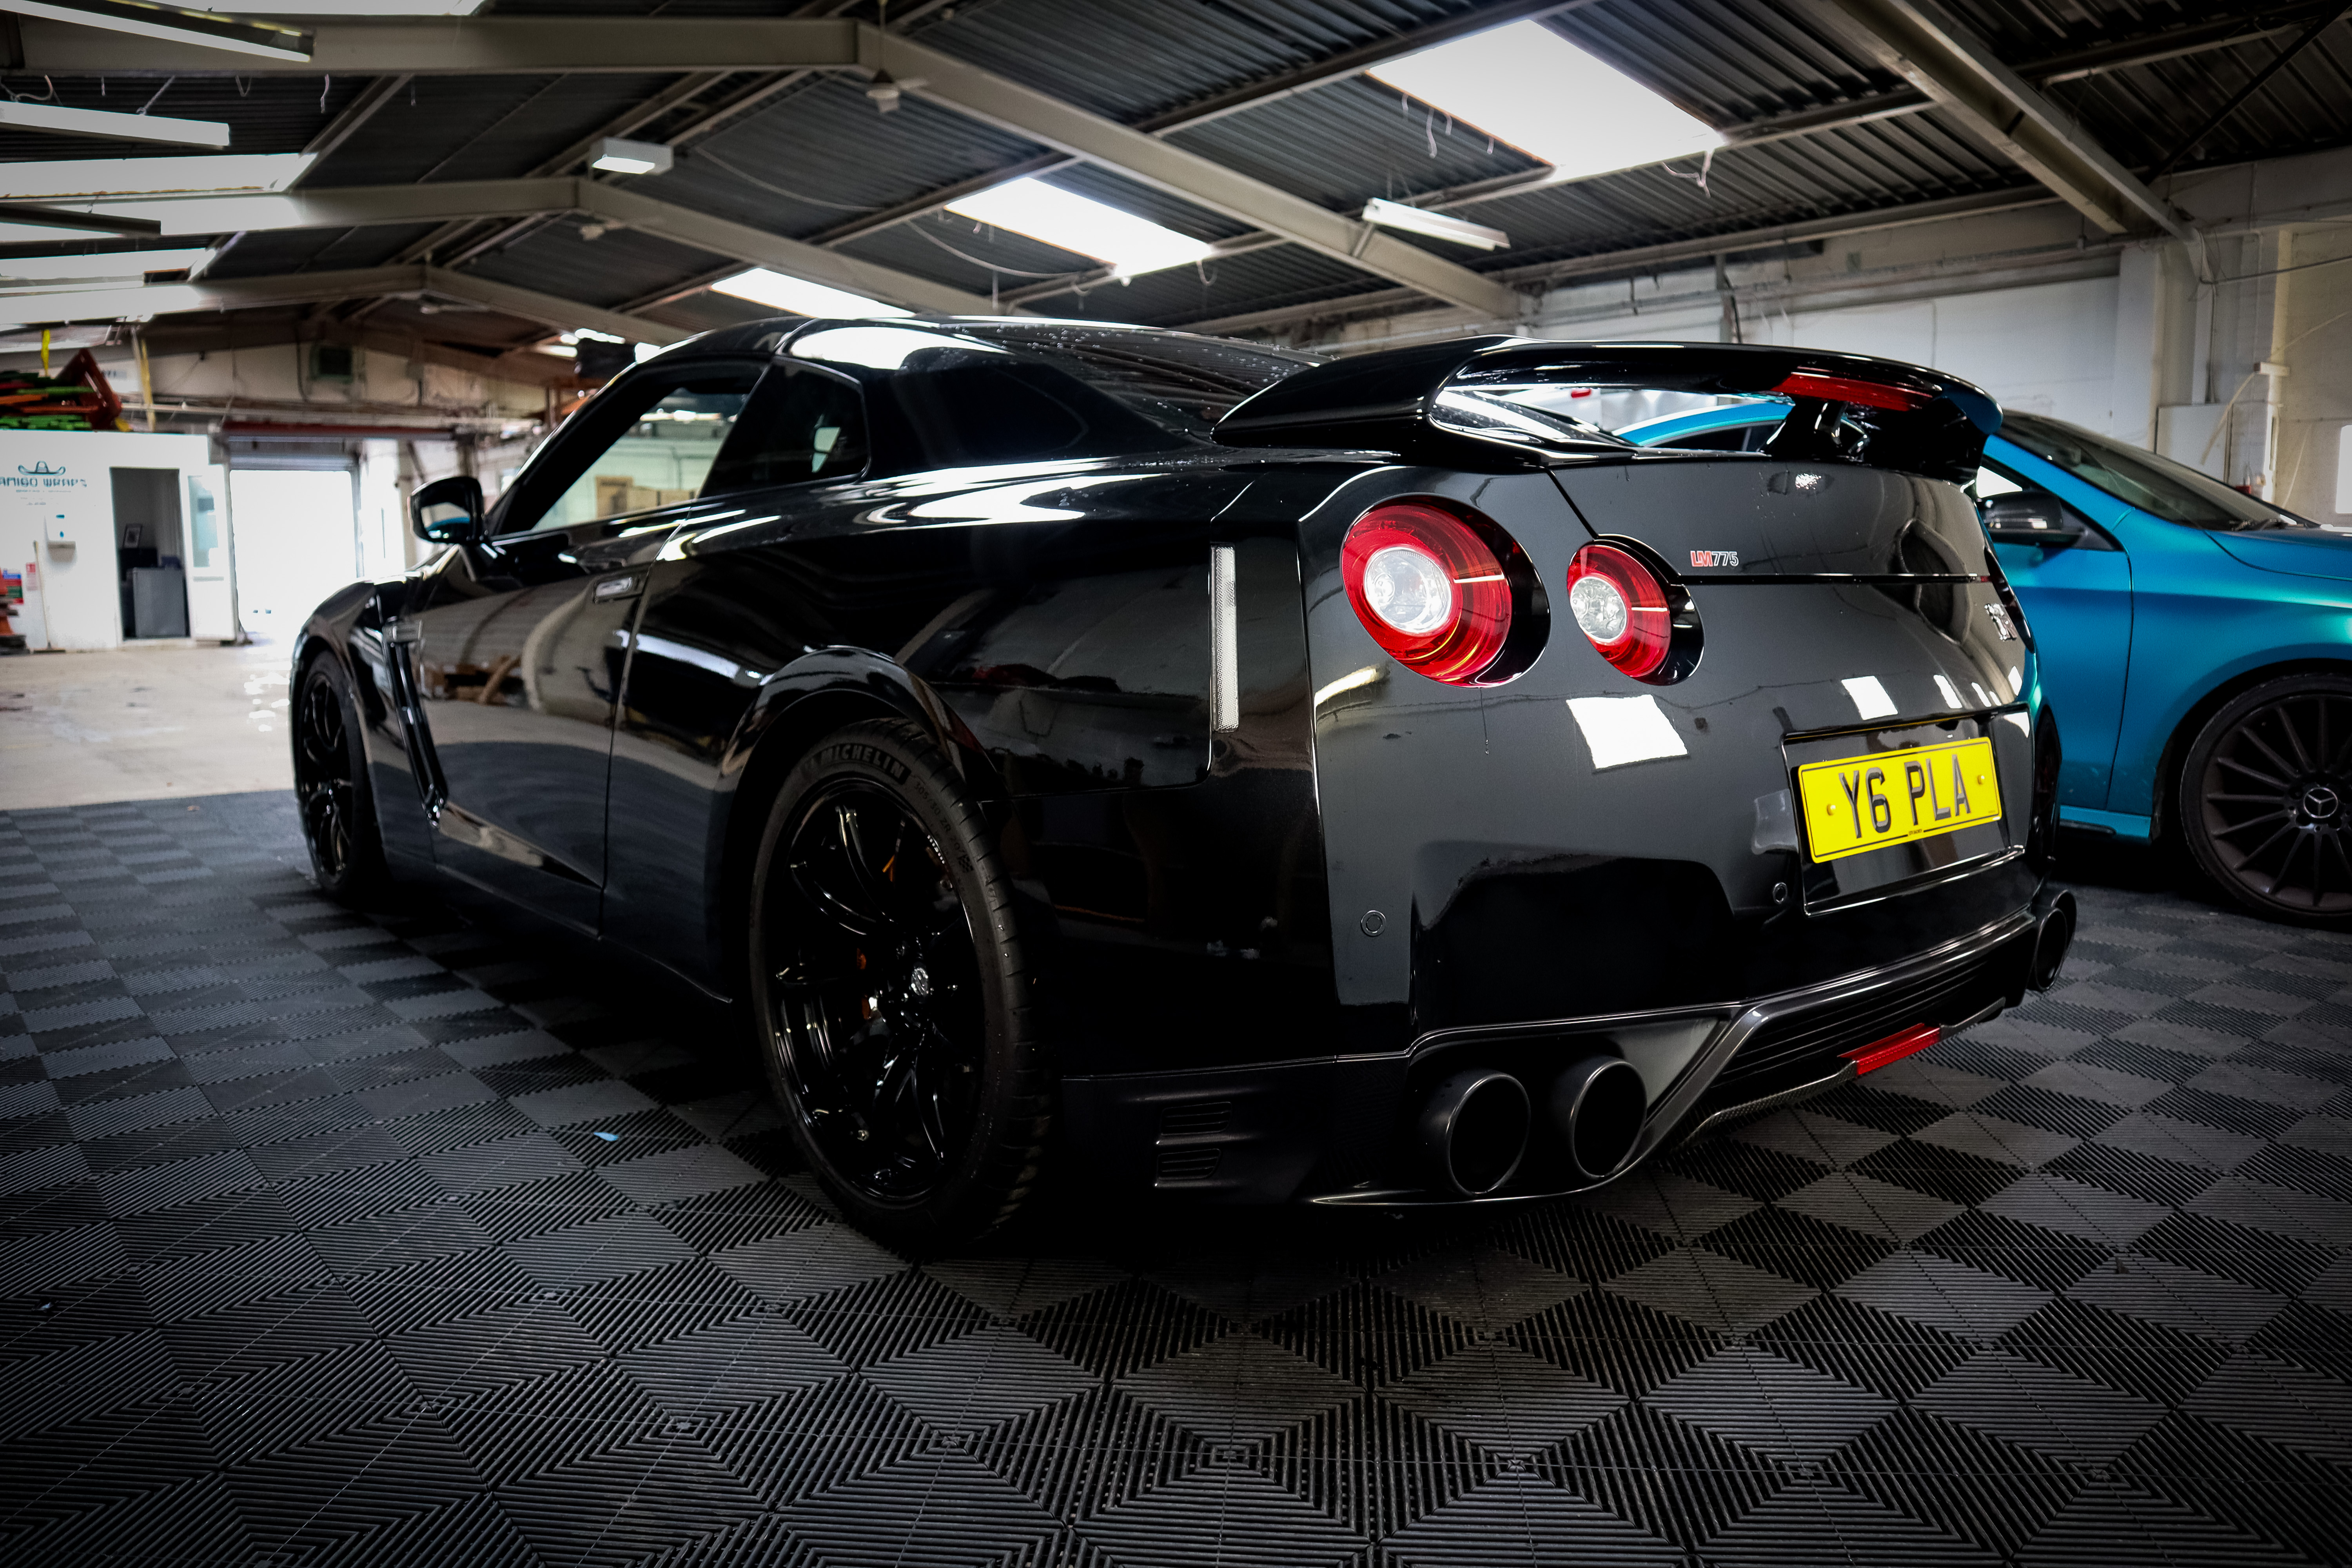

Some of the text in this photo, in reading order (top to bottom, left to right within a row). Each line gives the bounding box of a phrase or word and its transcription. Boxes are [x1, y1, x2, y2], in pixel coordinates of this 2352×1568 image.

[1690, 550, 1739, 567] LM775
[820, 744, 906, 779] MICHELIN
[1838, 754, 1971, 838] Y6 PLA
[940, 817, 951, 833] ZR
